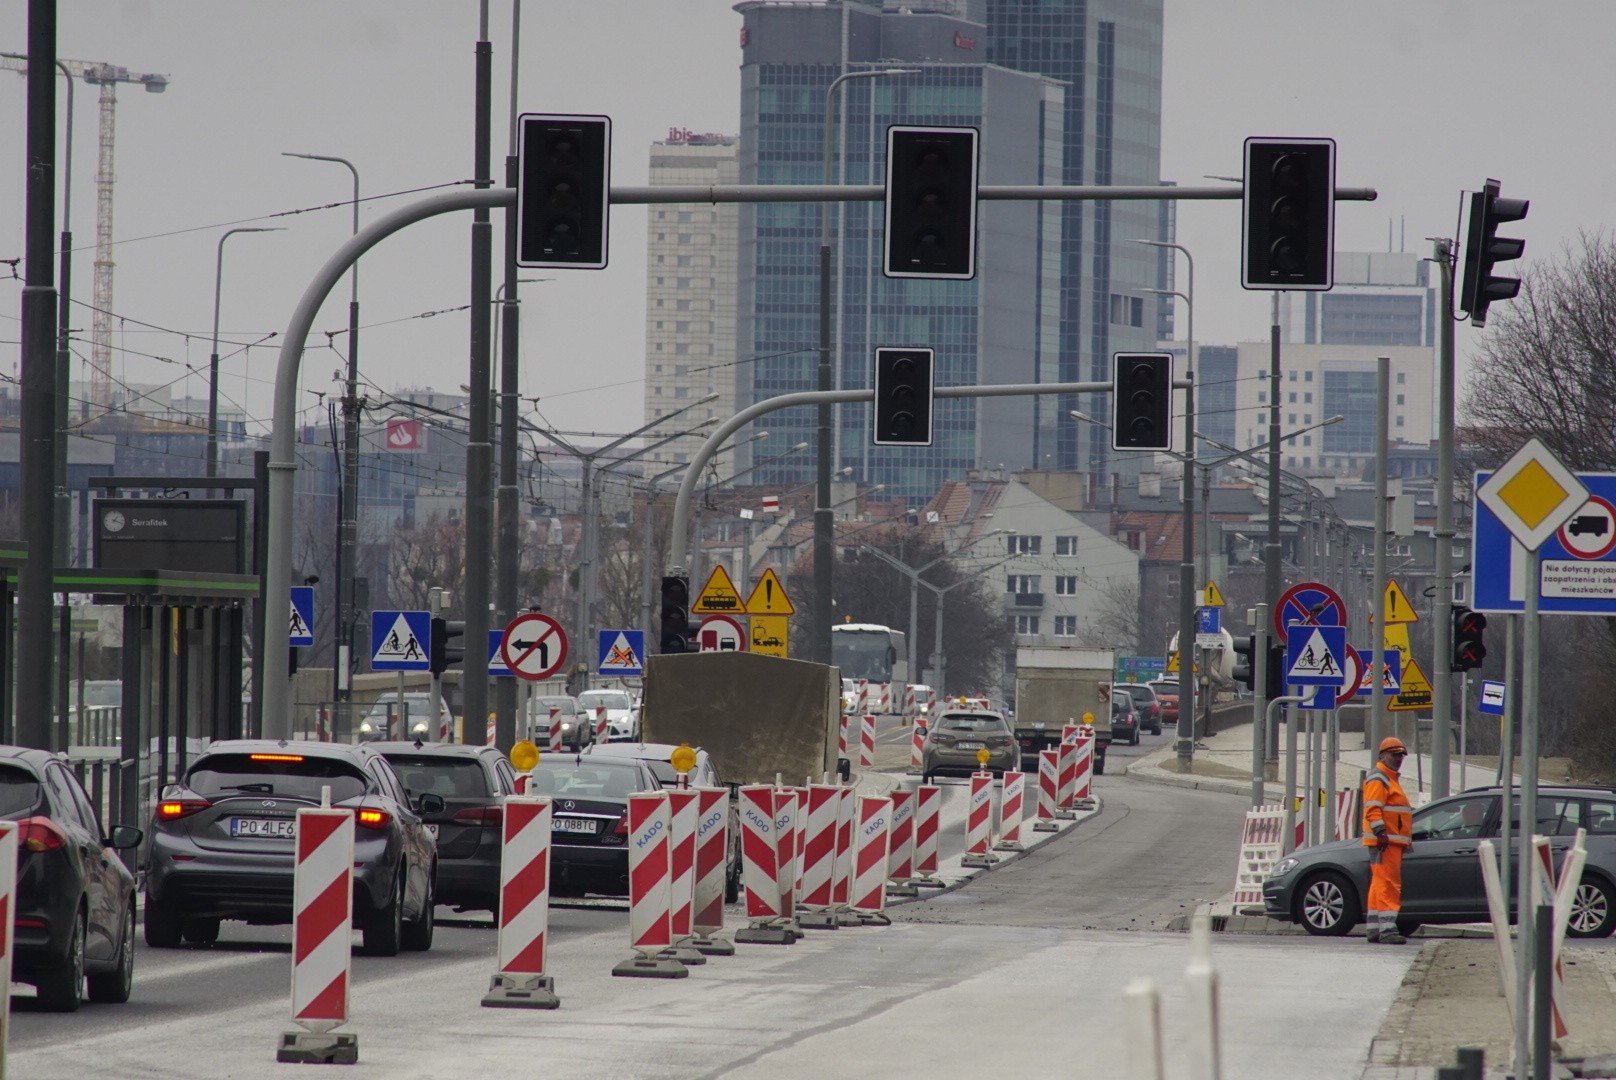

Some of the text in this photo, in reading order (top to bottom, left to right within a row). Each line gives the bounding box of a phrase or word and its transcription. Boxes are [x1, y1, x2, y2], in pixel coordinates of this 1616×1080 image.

[669, 127, 693, 142] ibis
[132, 518, 168, 527] Serafitek
[1546, 564, 1559, 572] Nie
[1562, 565, 1590, 574] dotyczy
[745, 809, 769, 833] KADO
[893, 806, 910, 822] KADO
[240, 821, 296, 835] PO 4LF6
[564, 820, 594, 831] 088TC
[698, 812, 722, 837] KADO
[864, 817, 885, 836] KADO
[636, 820, 663, 848] KADO
